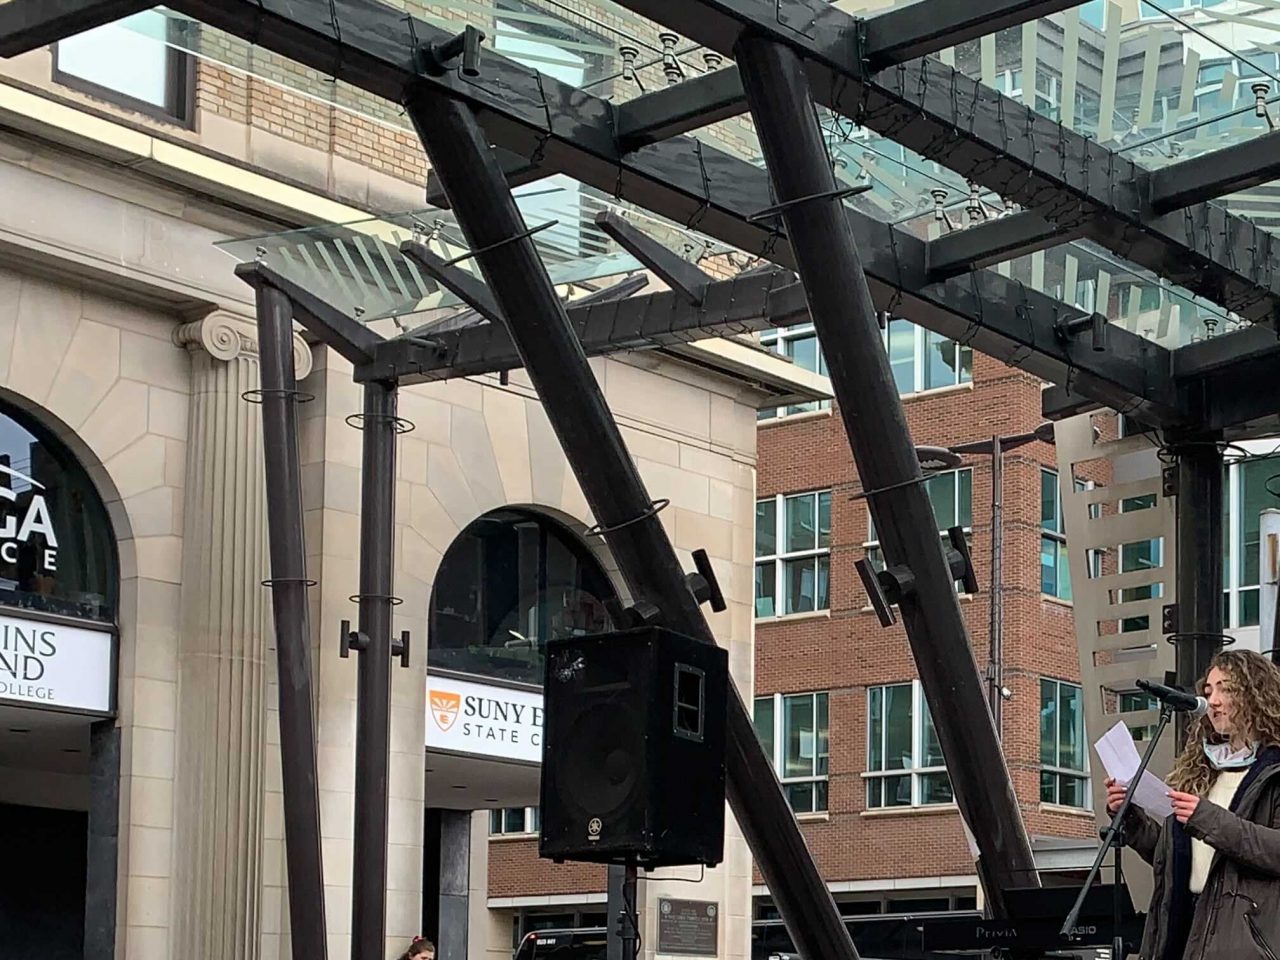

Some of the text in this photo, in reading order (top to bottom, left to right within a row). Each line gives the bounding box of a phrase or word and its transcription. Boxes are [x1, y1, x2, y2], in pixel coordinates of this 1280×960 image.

[464, 695, 526, 724] SUNY
[463, 723, 518, 743] STATE
[1071, 926, 1096, 935] ASIO
